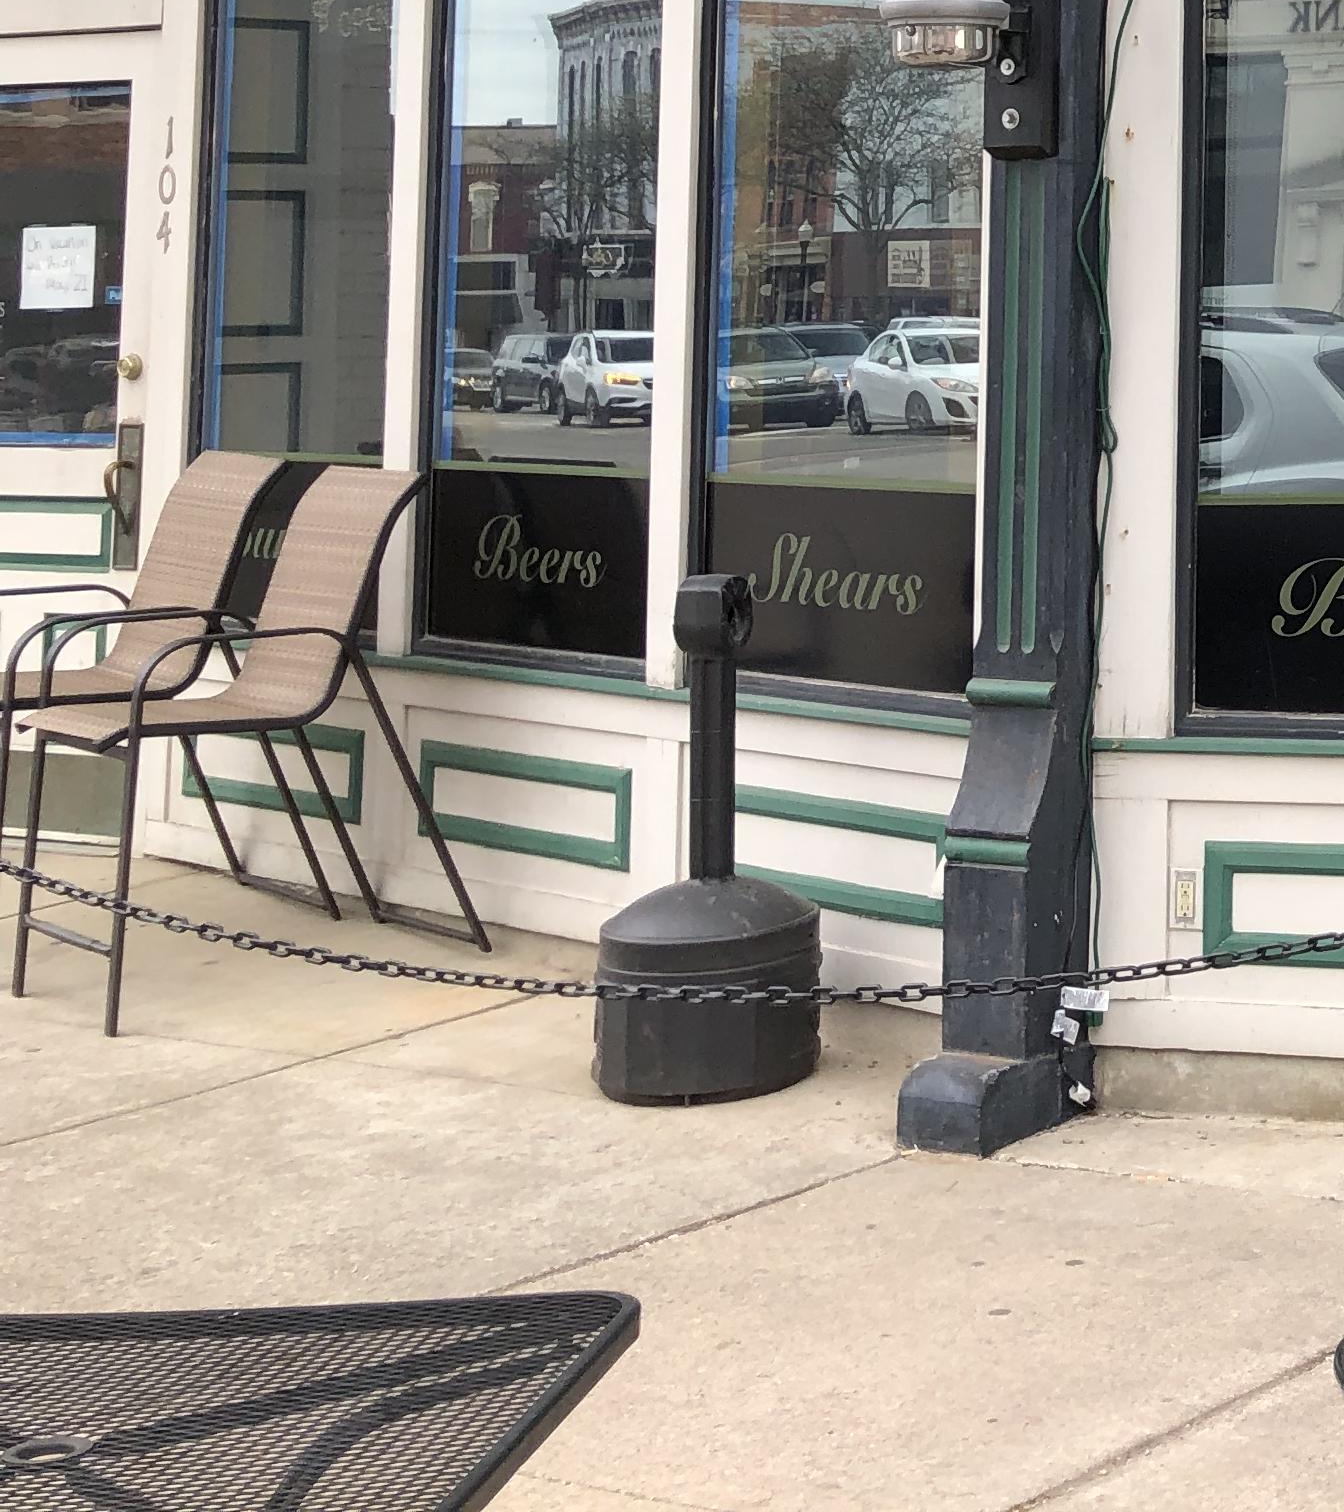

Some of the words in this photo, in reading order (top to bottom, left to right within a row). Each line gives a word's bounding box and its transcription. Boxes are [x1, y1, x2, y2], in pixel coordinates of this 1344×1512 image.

[155, 115, 177, 255] 104
[473, 514, 607, 587] Beers
[748, 532, 927, 615] Shears
